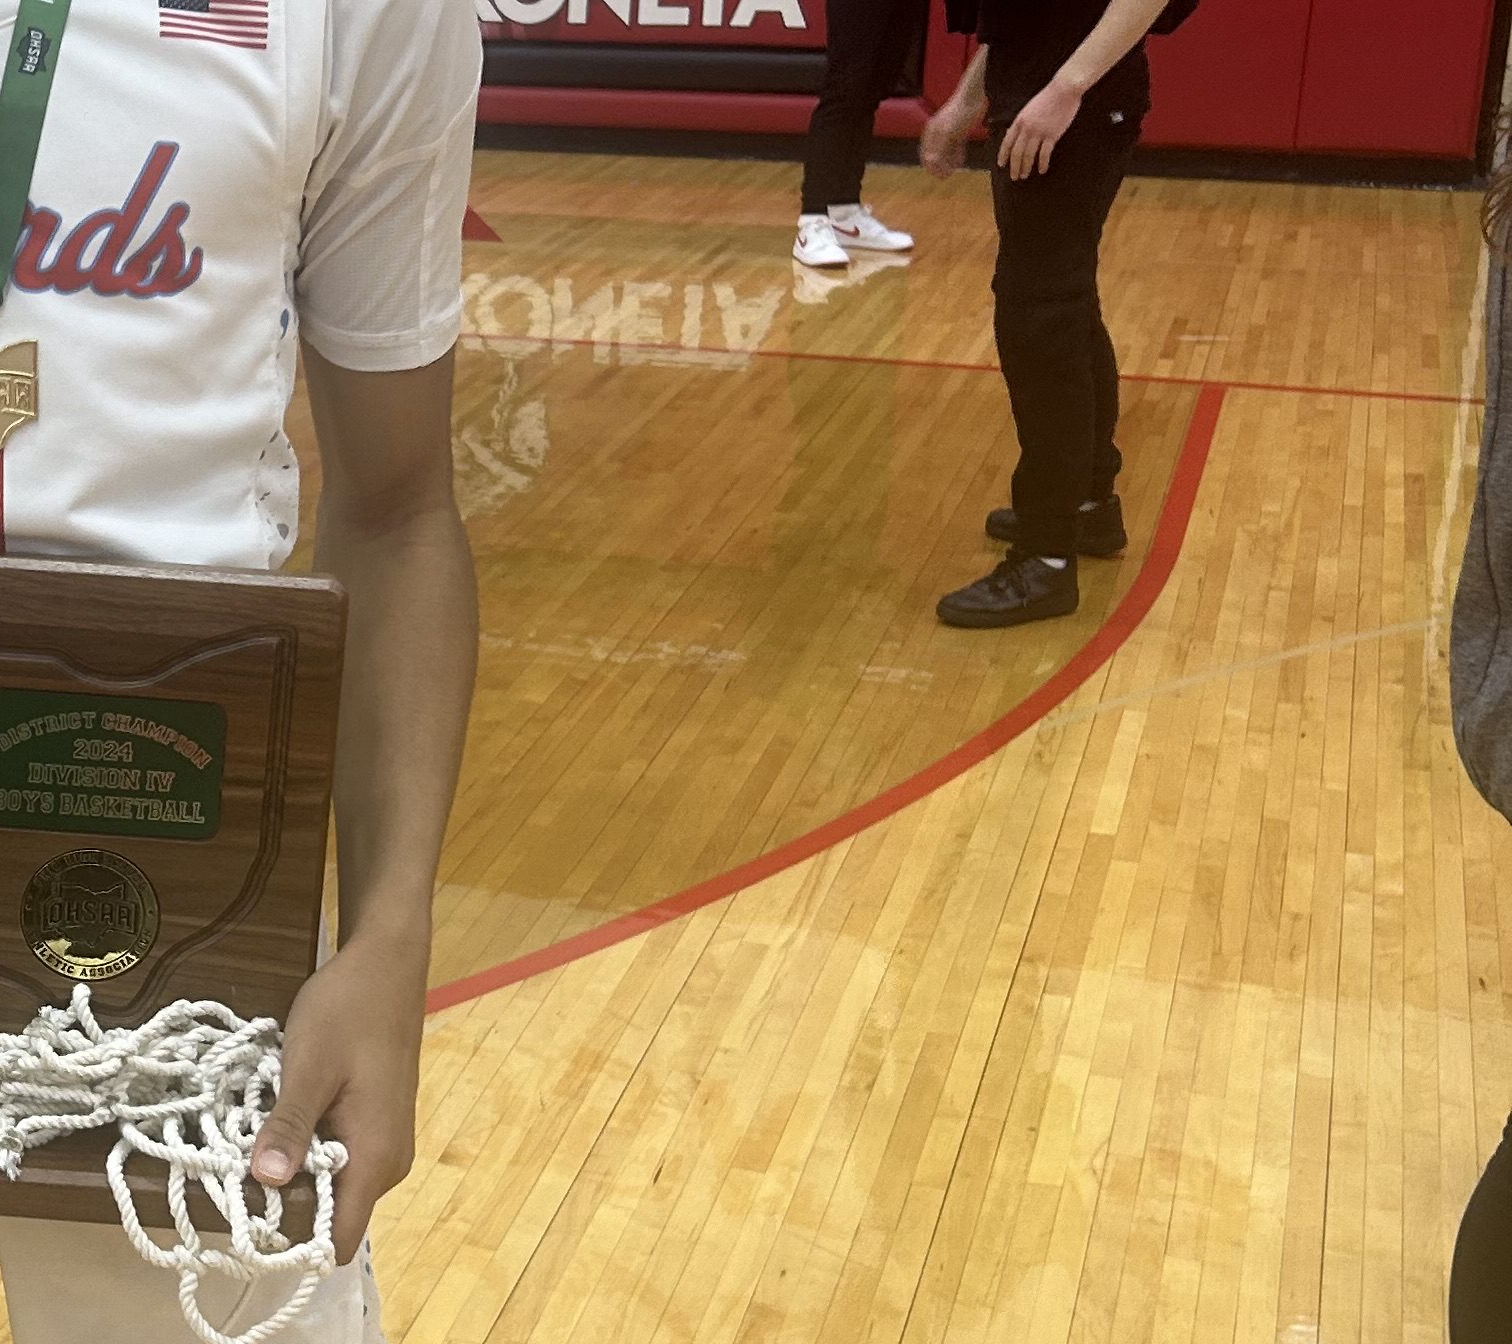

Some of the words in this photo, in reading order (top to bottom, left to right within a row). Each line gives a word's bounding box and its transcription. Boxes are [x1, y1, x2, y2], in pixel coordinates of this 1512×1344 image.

[22, 28, 44, 74] OHSAA
[72, 737, 134, 763] 2024
[100, 711, 213, 770] CHAMPION
[27, 761, 141, 791] DIVISION
[145, 769, 177, 793] IV
[58, 792, 206, 825] BASKETBALL
[46, 900, 133, 932] OHSAA
